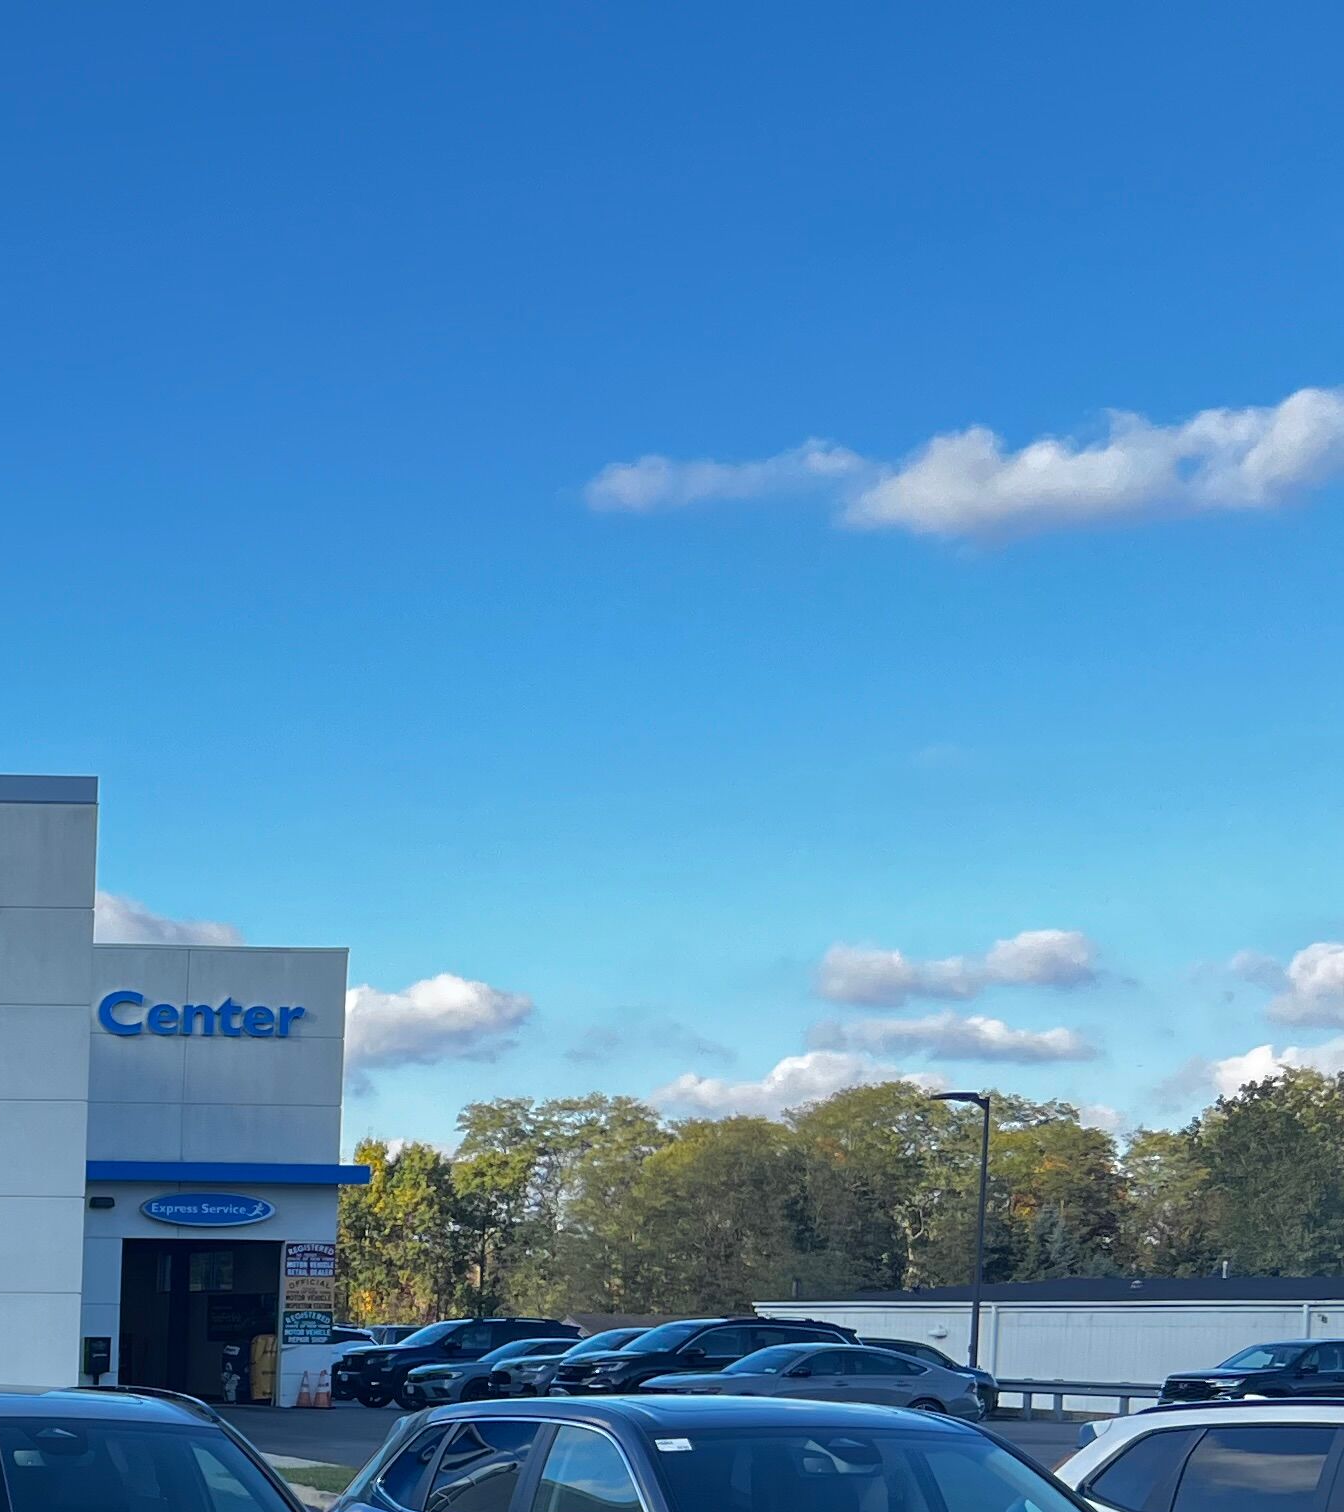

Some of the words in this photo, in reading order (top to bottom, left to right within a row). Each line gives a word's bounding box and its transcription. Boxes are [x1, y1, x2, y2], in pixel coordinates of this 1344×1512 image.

[98, 990, 306, 1038] Center
[151, 1202, 198, 1216] Express
[201, 1203, 247, 1215] Service
[287, 1244, 335, 1256] REGISTERED
[288, 1279, 331, 1290] OFFICIAL
[285, 1311, 331, 1324] REGISTERED
